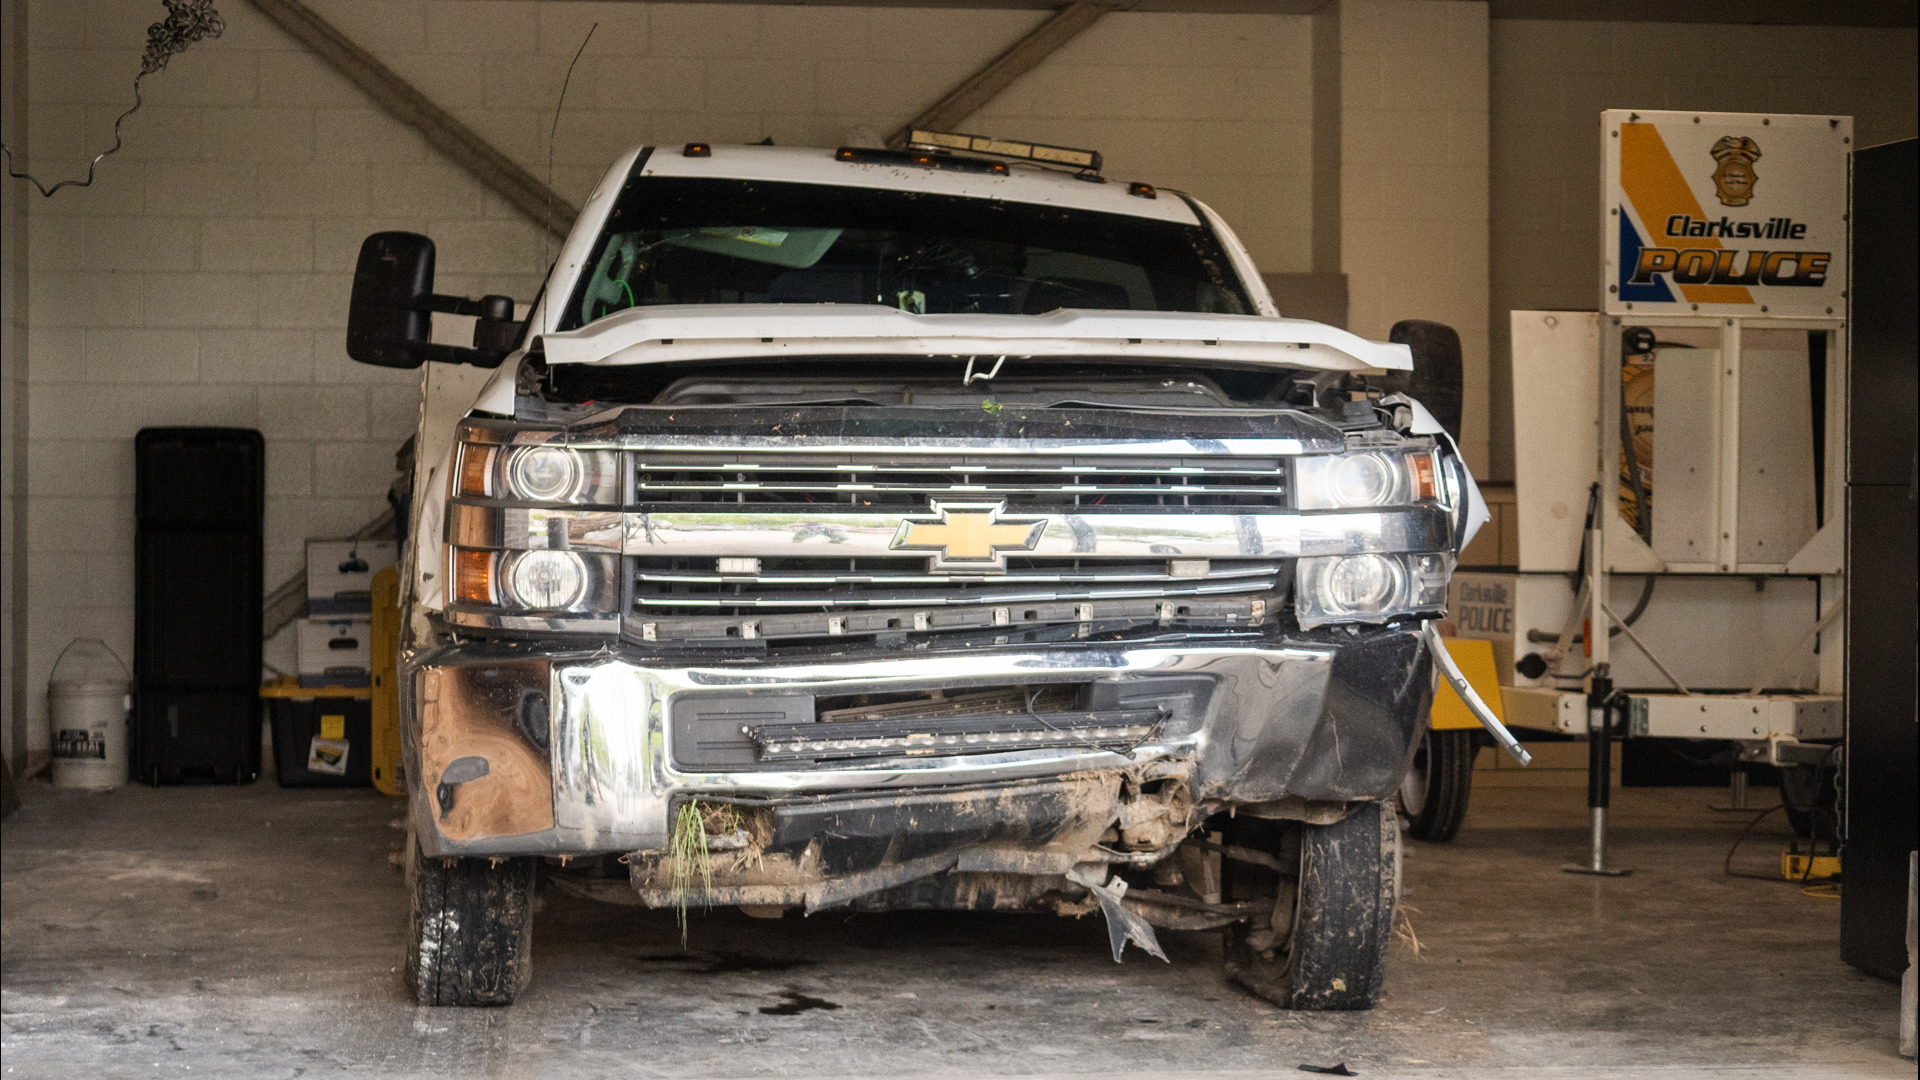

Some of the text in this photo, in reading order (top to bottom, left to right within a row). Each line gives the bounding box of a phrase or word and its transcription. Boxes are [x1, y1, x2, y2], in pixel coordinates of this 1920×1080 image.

[1666, 214, 1807, 239] Clarksville
[1628, 247, 1832, 287] POLICE
[1458, 605, 1512, 633] POLICE
